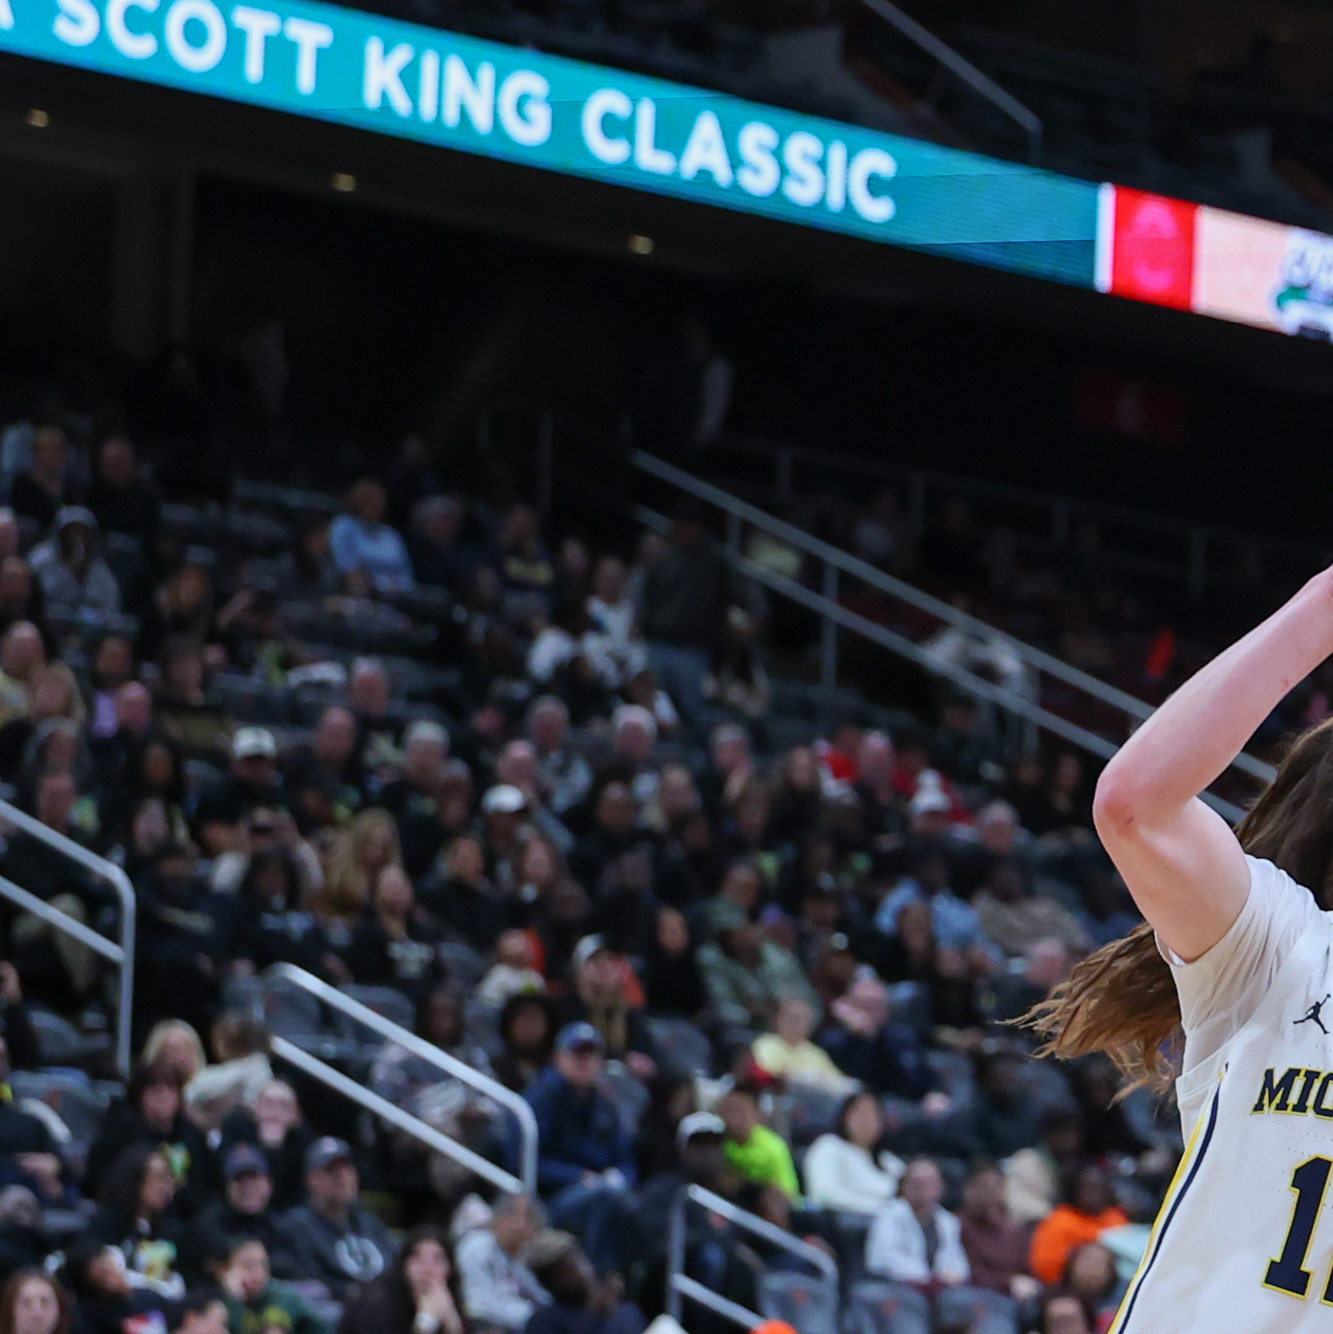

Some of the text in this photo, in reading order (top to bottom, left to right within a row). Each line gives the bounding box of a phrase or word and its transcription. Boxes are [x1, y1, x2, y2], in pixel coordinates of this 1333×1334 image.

[53, 0, 896, 224] SCOTT KING CLASSIC
